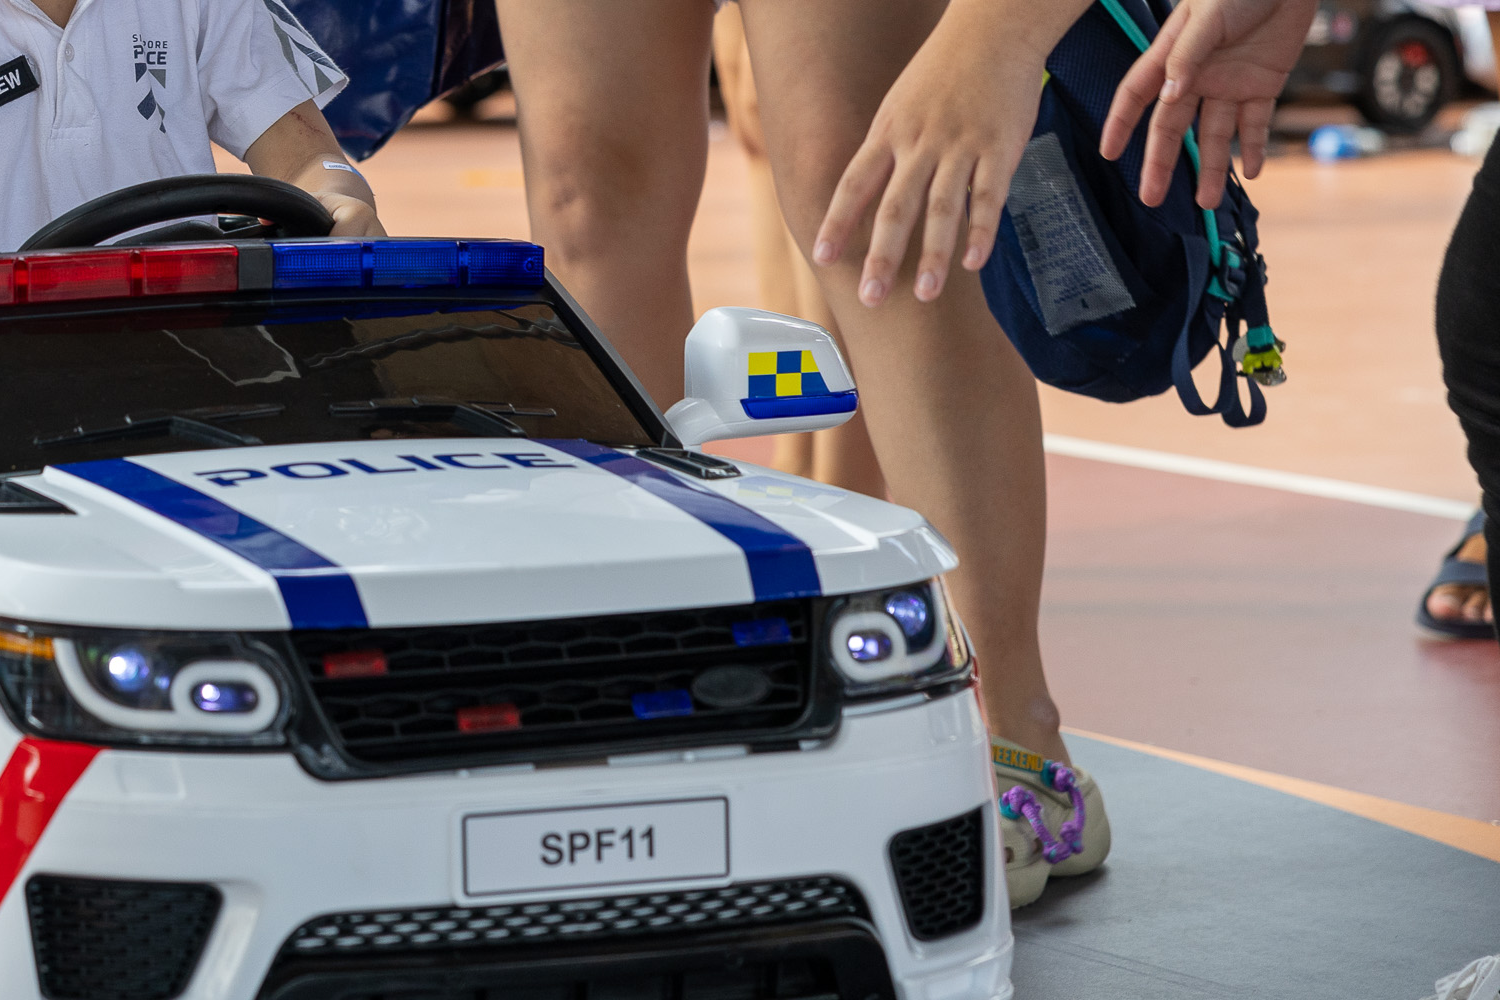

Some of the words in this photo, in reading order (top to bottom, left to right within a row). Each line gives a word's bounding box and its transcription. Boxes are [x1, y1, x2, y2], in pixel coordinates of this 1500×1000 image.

[133, 44, 168, 65] PCE
[194, 452, 578, 487] POLICE
[540, 825, 654, 866] SPF11
